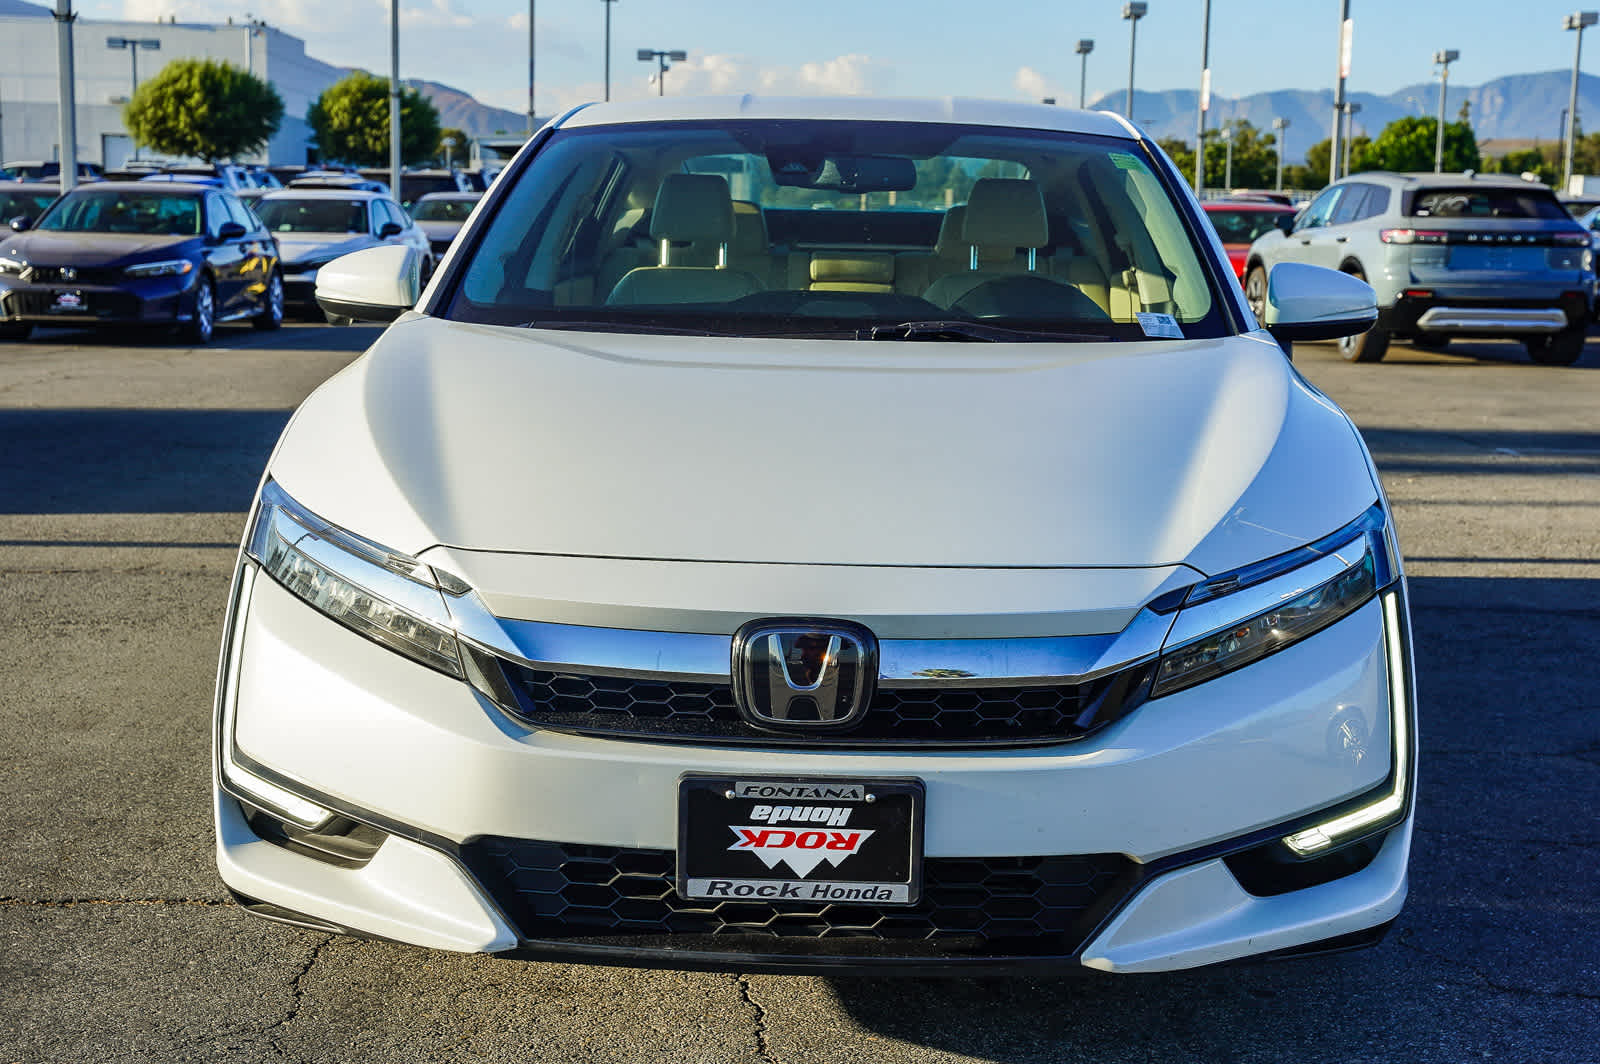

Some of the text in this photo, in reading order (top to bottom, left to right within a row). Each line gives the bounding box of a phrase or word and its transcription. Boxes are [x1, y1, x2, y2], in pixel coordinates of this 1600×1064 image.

[742, 786, 860, 799] FONTANA
[750, 805, 852, 826] Honda
[740, 830, 860, 850] ROCK
[706, 880, 892, 900] Rock Honda
